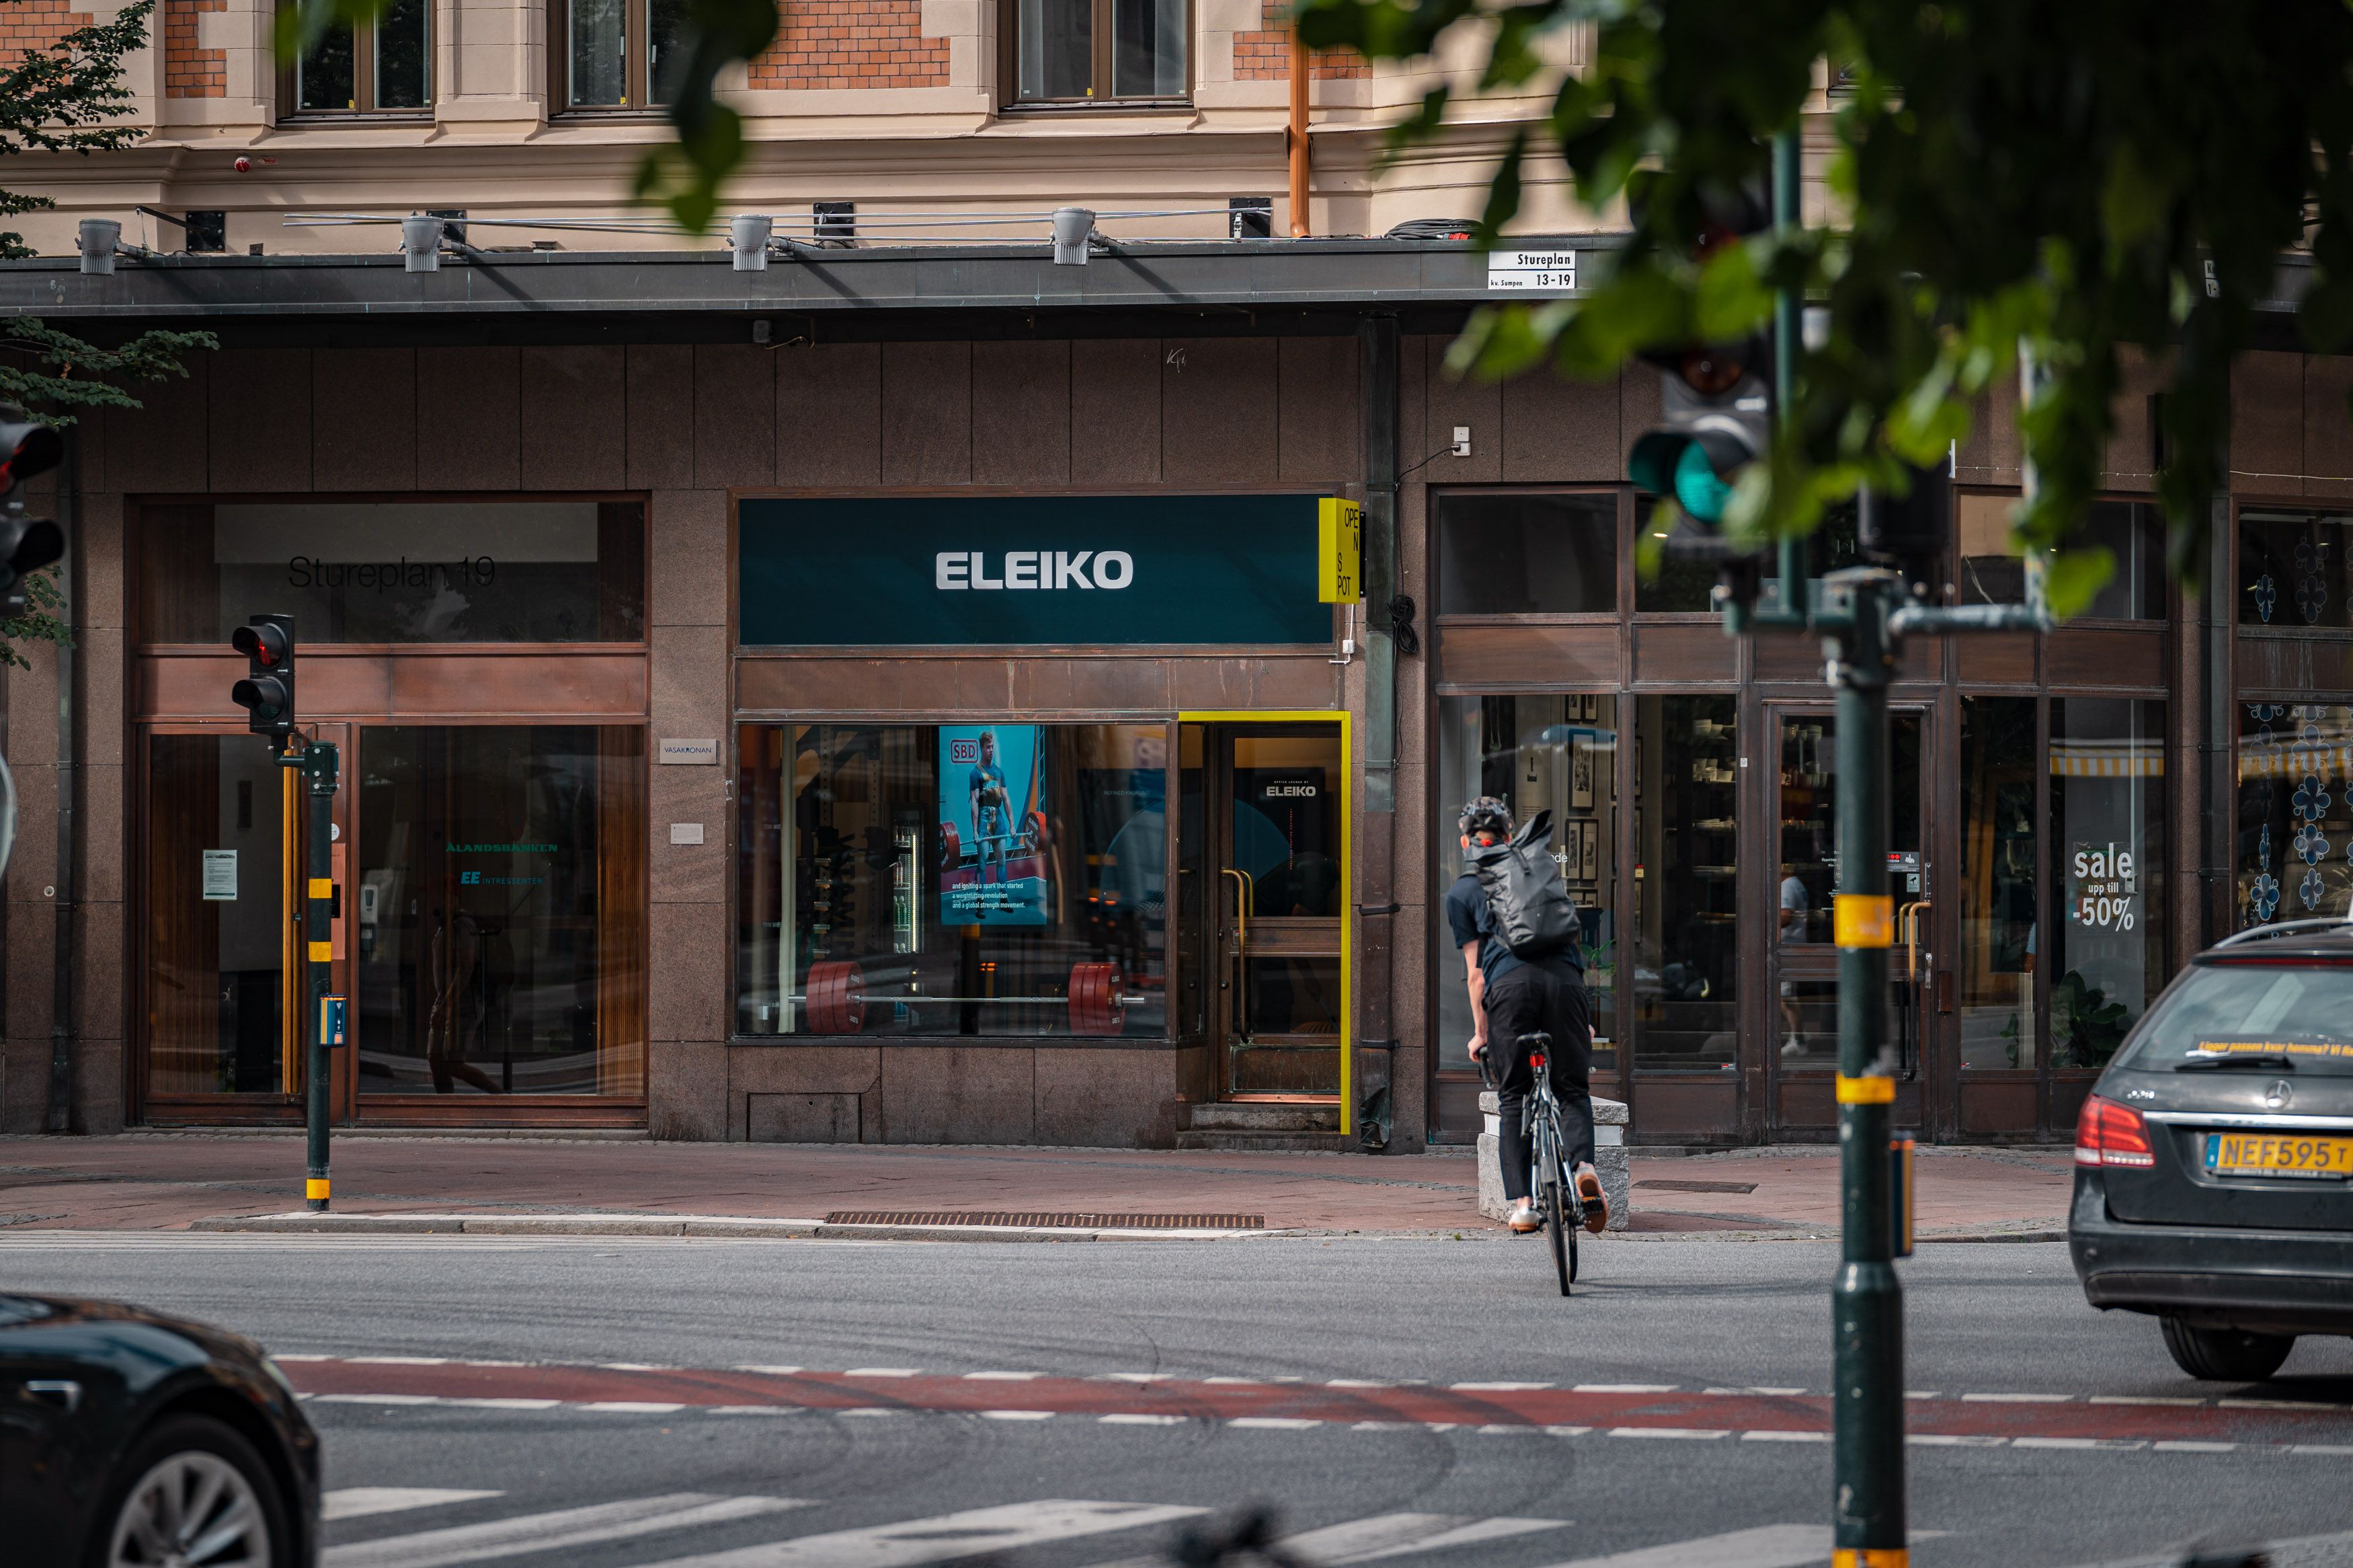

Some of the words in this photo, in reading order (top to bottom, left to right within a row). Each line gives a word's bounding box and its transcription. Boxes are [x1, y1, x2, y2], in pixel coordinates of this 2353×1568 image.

[1517, 253, 1570, 268] Stureplan
[1345, 507, 1358, 529] OPE
[1353, 532, 1358, 552] N
[936, 550, 1133, 589] ELEIKO
[1337, 552, 1343, 572] S
[288, 556, 447, 595] Stureplan
[458, 556, 495, 587] 19
[1337, 575, 1351, 596] POT
[953, 744, 975, 759] SBD
[1267, 786, 1316, 796] ELEIKO
[446, 842, 558, 852] ÅLANDSBANKEN
[2075, 843, 2132, 878] sale
[461, 872, 481, 884] EE
[983, 882, 996, 891] spark
[2088, 884, 2104, 896] upp
[2107, 882, 2119, 893] till
[2073, 897, 2135, 932] -50%
[2223, 1139, 2331, 1167] NEF595
